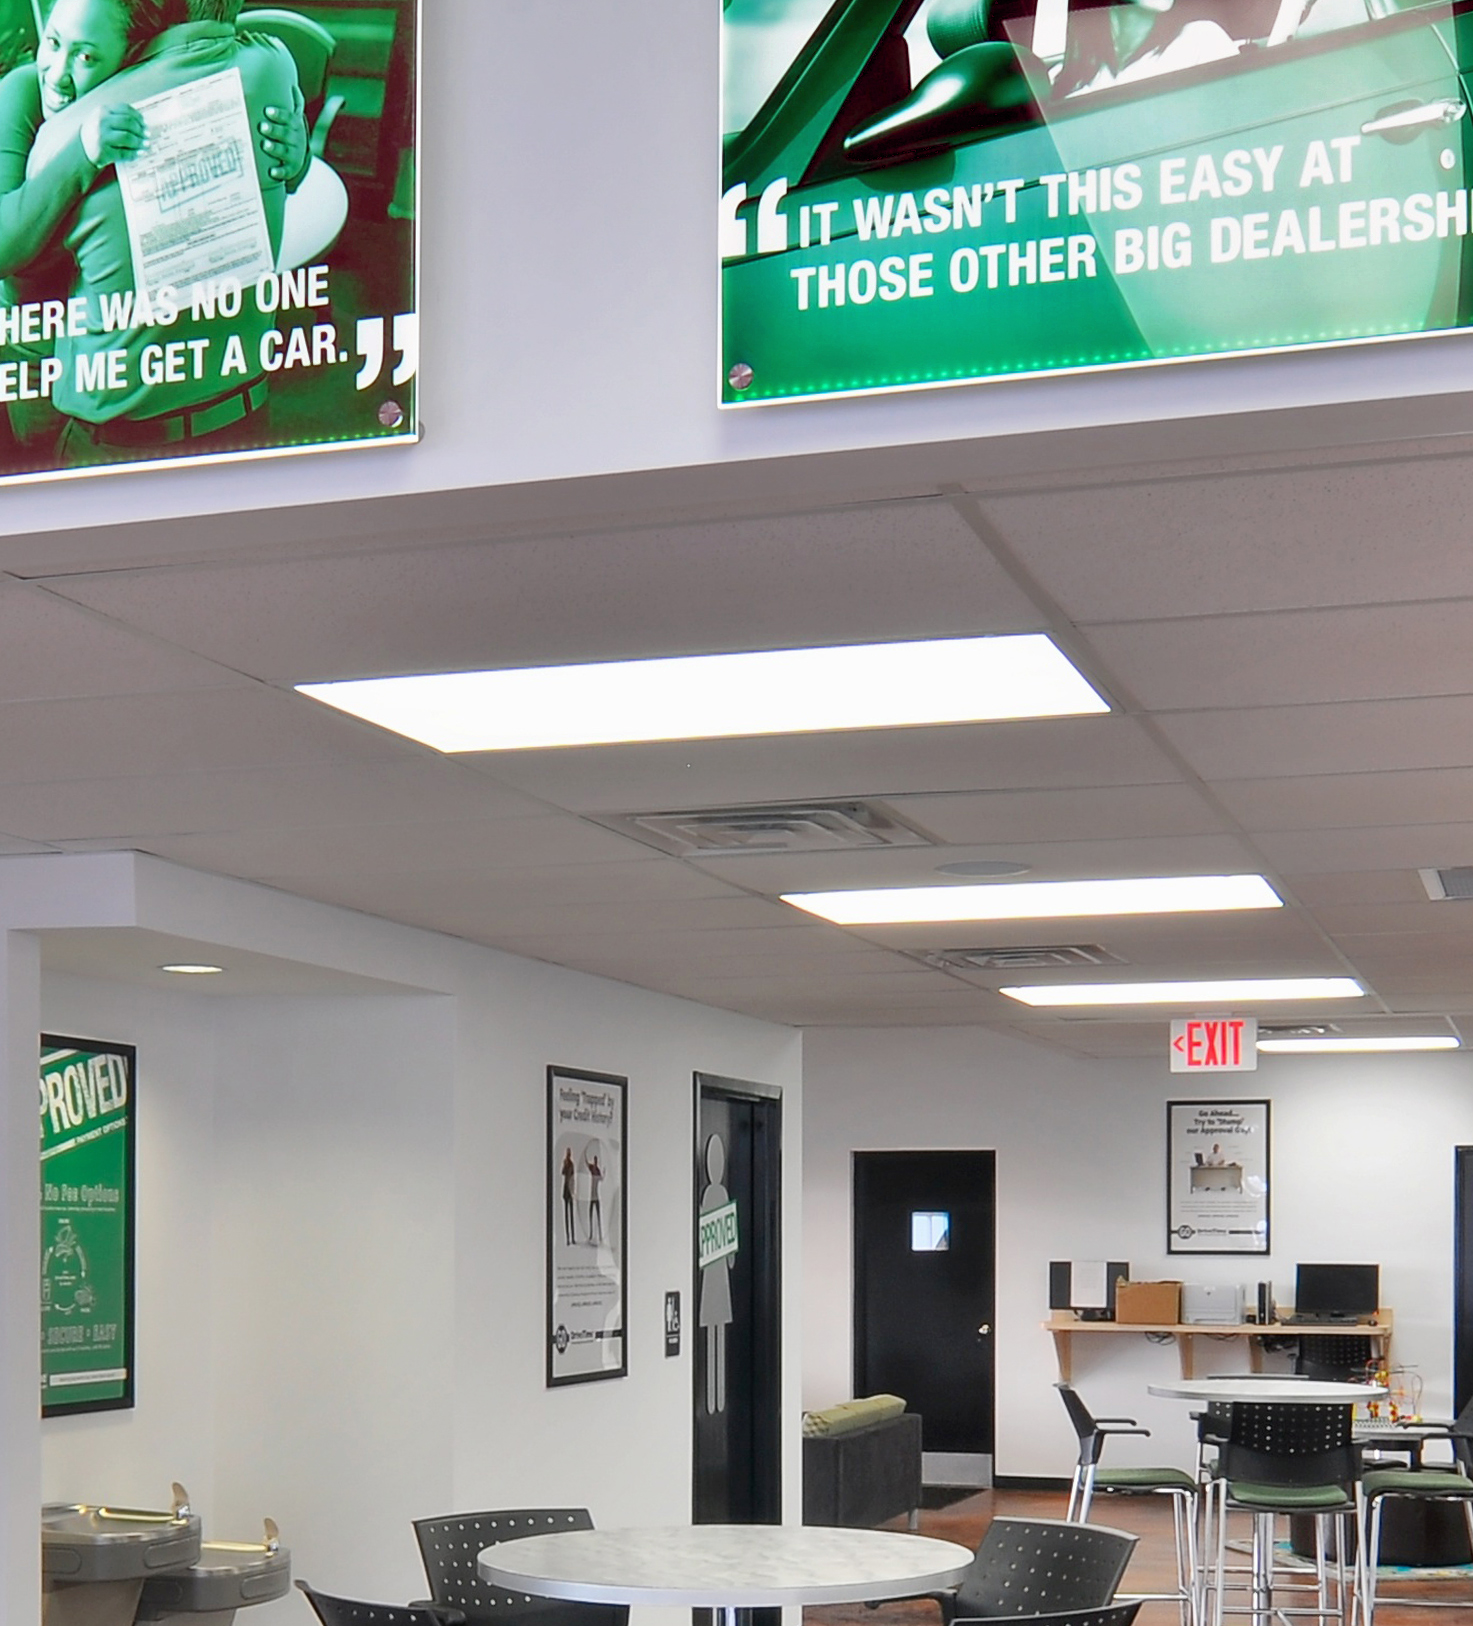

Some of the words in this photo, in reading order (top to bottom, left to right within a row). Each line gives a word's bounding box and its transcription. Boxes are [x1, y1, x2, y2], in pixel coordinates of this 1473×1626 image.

[799, 203, 838, 251] IT
[852, 180, 1024, 243] WASN'T
[1040, 163, 1143, 221] THIS
[1159, 148, 1284, 205] EASY
[1300, 136, 1362, 190] AT
[99, 286, 178, 332] WAS
[192, 276, 243, 322] NO
[256, 265, 330, 312] ONE
[790, 259, 934, 312] THOSE
[948, 238, 1098, 299] OTHER
[1114, 222, 1193, 276] BIG
[75, 351, 128, 394] ME
[140, 341, 210, 387] GET
[220, 335, 248, 376] A
[259, 323, 348, 371] CAR.
[1187, 1021, 1245, 1067] EXIT
[700, 1211, 737, 1257] PPROVED
